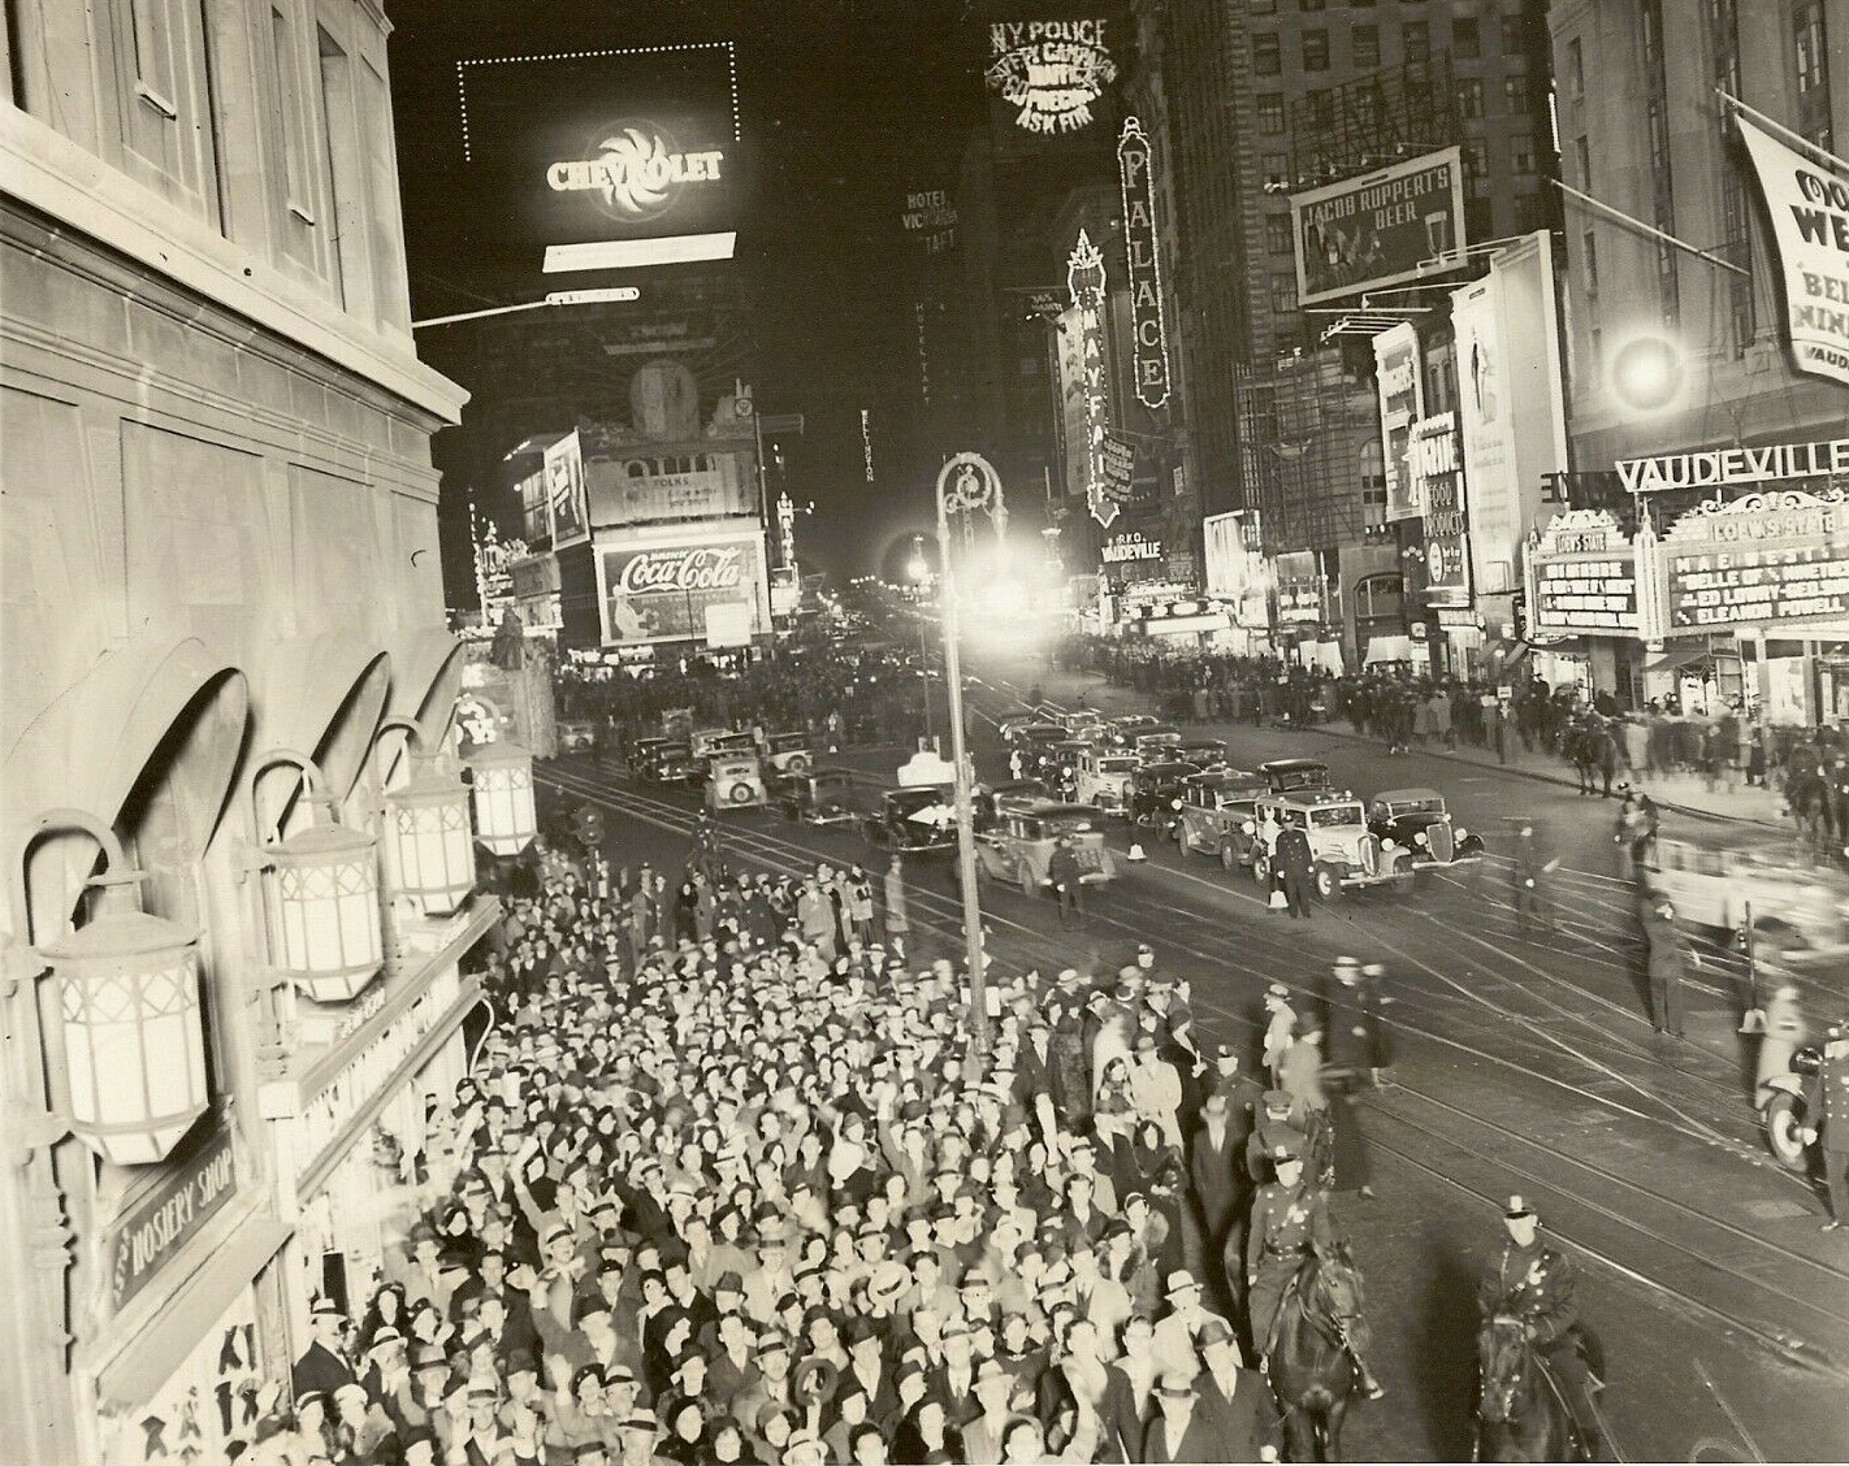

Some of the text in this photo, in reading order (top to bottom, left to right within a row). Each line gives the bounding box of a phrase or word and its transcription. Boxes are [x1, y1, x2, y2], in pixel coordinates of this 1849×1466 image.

[1029, 20, 1107, 45] POLICE
[1015, 108, 1057, 134] ASK
[546, 150, 724, 192] CHEVROLET
[907, 190, 945, 209] HOTEL
[1306, 167, 1449, 227] JACOB RUPPERT'S
[1375, 201, 1418, 230] BEER
[1123, 150, 1163, 387] PALACE
[916, 303, 927, 356] HOTEL
[1083, 309, 1105, 503] MAYFAIR
[1614, 438, 1849, 493] VAUDEVILLE
[1101, 541, 1161, 563] VAUDEVILLE
[1676, 553, 1729, 573] MAE
[1696, 602, 1773, 624] ELEANOR
[1778, 596, 1846, 617] POWELL
[1697, 590, 1721, 607] ED
[132, 1181, 195, 1277] HOSIERY
[198, 1147, 232, 1208] SHOP
